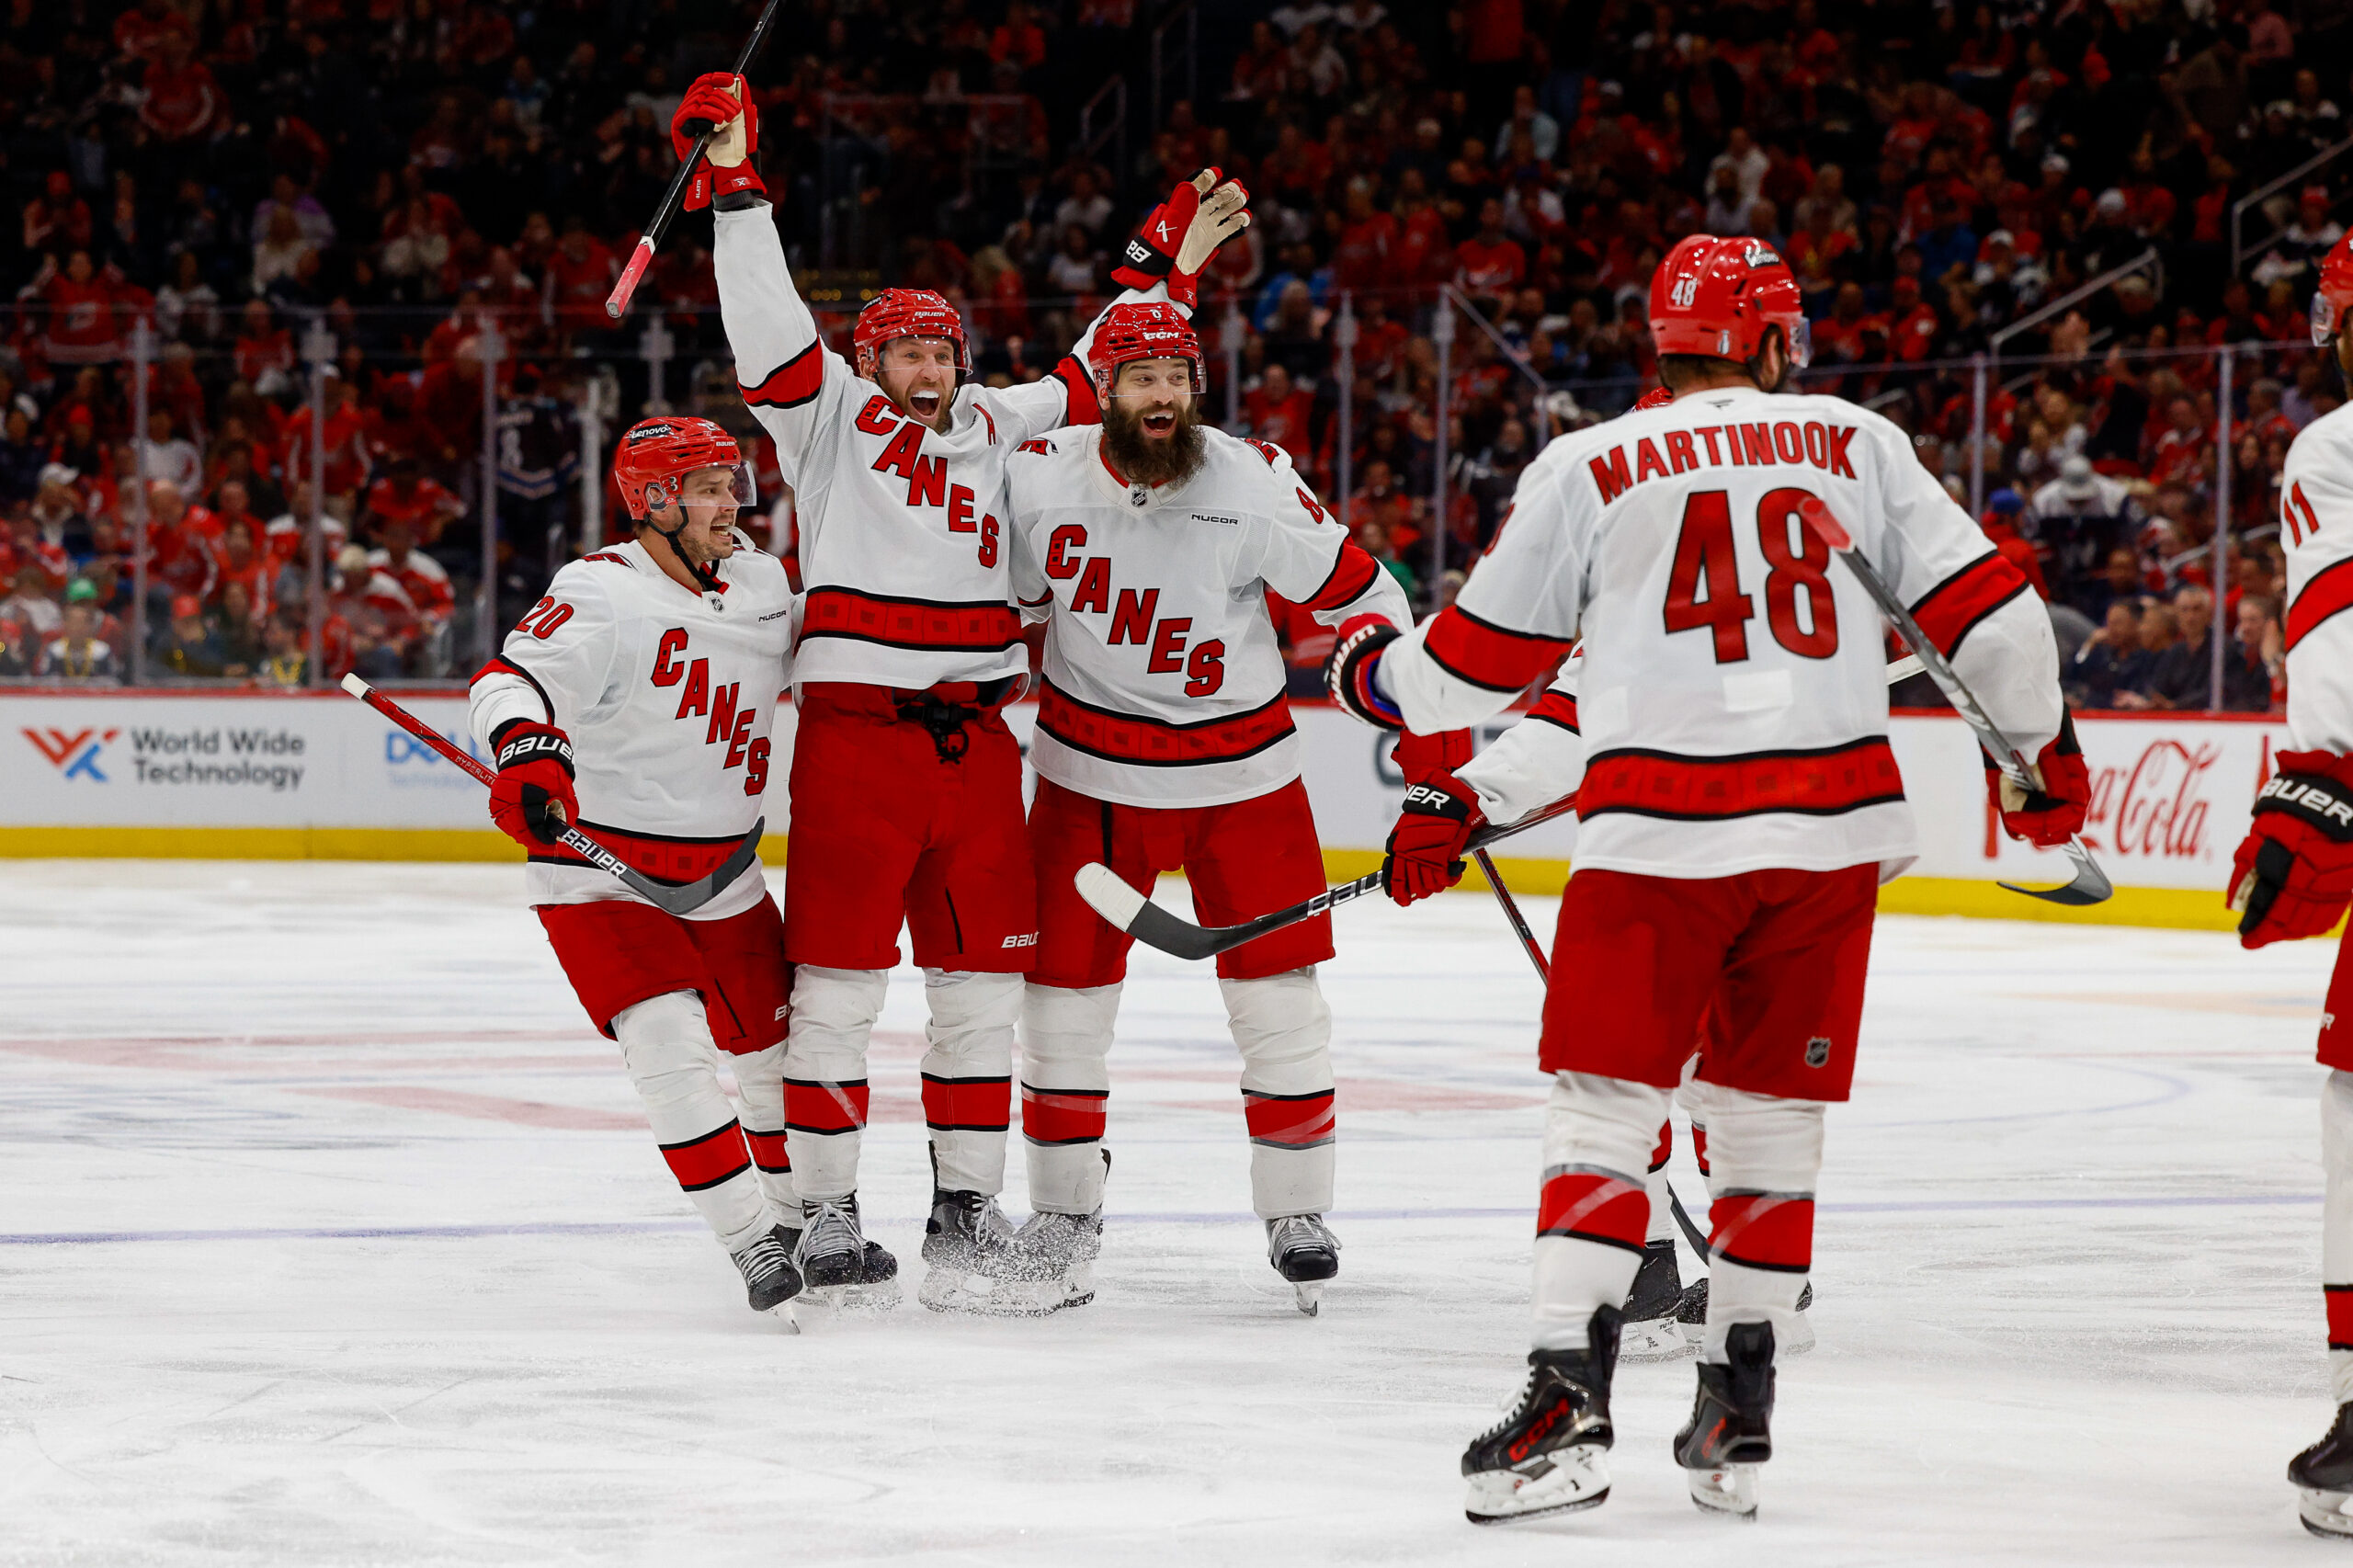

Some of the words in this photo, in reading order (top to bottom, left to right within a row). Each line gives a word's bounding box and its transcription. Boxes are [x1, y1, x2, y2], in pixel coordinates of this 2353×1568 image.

[1671, 278, 1697, 306] 48
[1142, 331, 1180, 341] CCM
[631, 425, 671, 440] Lenovo
[855, 394, 1000, 569] CANES
[1587, 421, 1858, 506] MARTINOOK
[1191, 514, 1238, 525] NUCOR
[1296, 485, 1324, 525] 8
[2283, 479, 2320, 550] 11
[1662, 486, 1840, 665] 48
[515, 596, 574, 640] 20
[758, 609, 787, 622] NUCOR
[1045, 523, 1225, 698] CANES
[651, 627, 771, 796] CANES
[131, 727, 220, 754] World
[229, 729, 306, 754] Wide
[499, 735, 575, 766] BAUE
[133, 758, 305, 791] Technology
[1507, 1397, 1570, 1462] CCM
